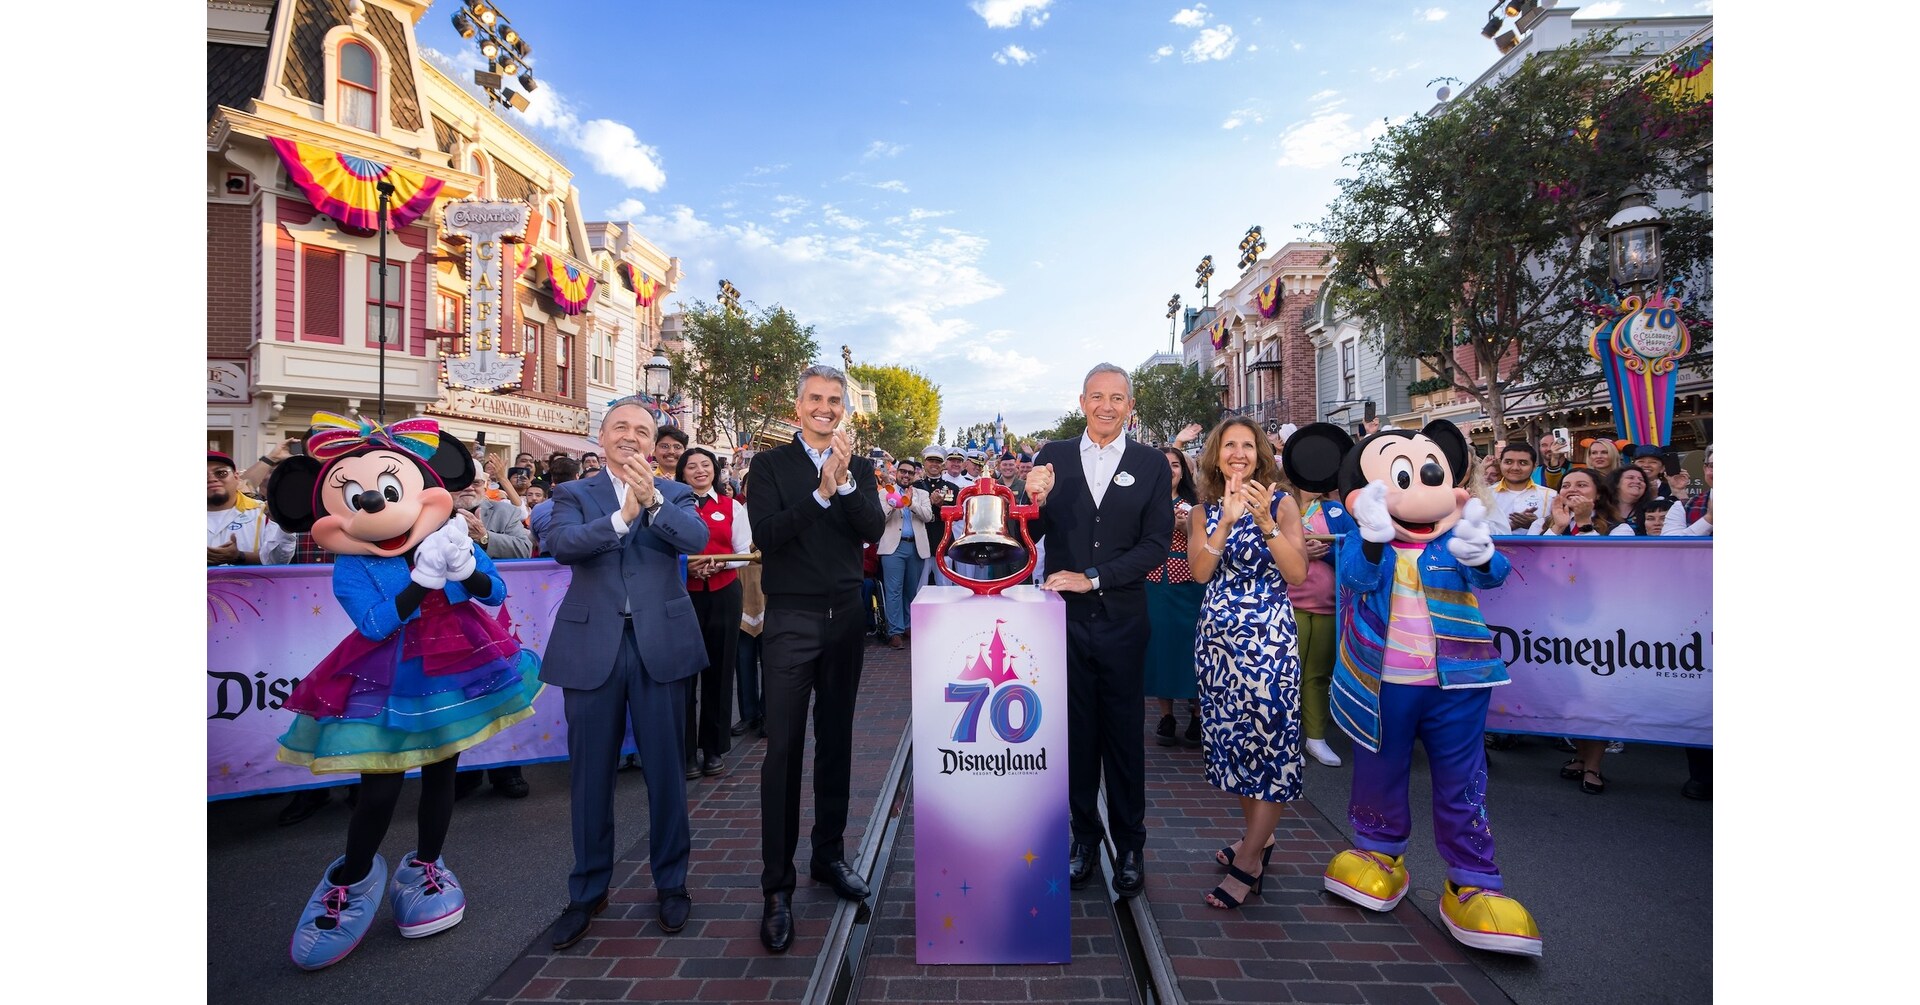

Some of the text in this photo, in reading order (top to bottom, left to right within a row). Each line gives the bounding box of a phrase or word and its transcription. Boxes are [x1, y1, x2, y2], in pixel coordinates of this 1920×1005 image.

[451, 211, 520, 228] CARNATION
[1643, 307, 1677, 329] 70
[482, 398, 531, 419] CARNATION
[1486, 624, 1706, 676] Disneyland
[1656, 671, 1703, 679] RESORT
[944, 682, 1043, 744] 70
[937, 747, 1048, 777] Disneyland
